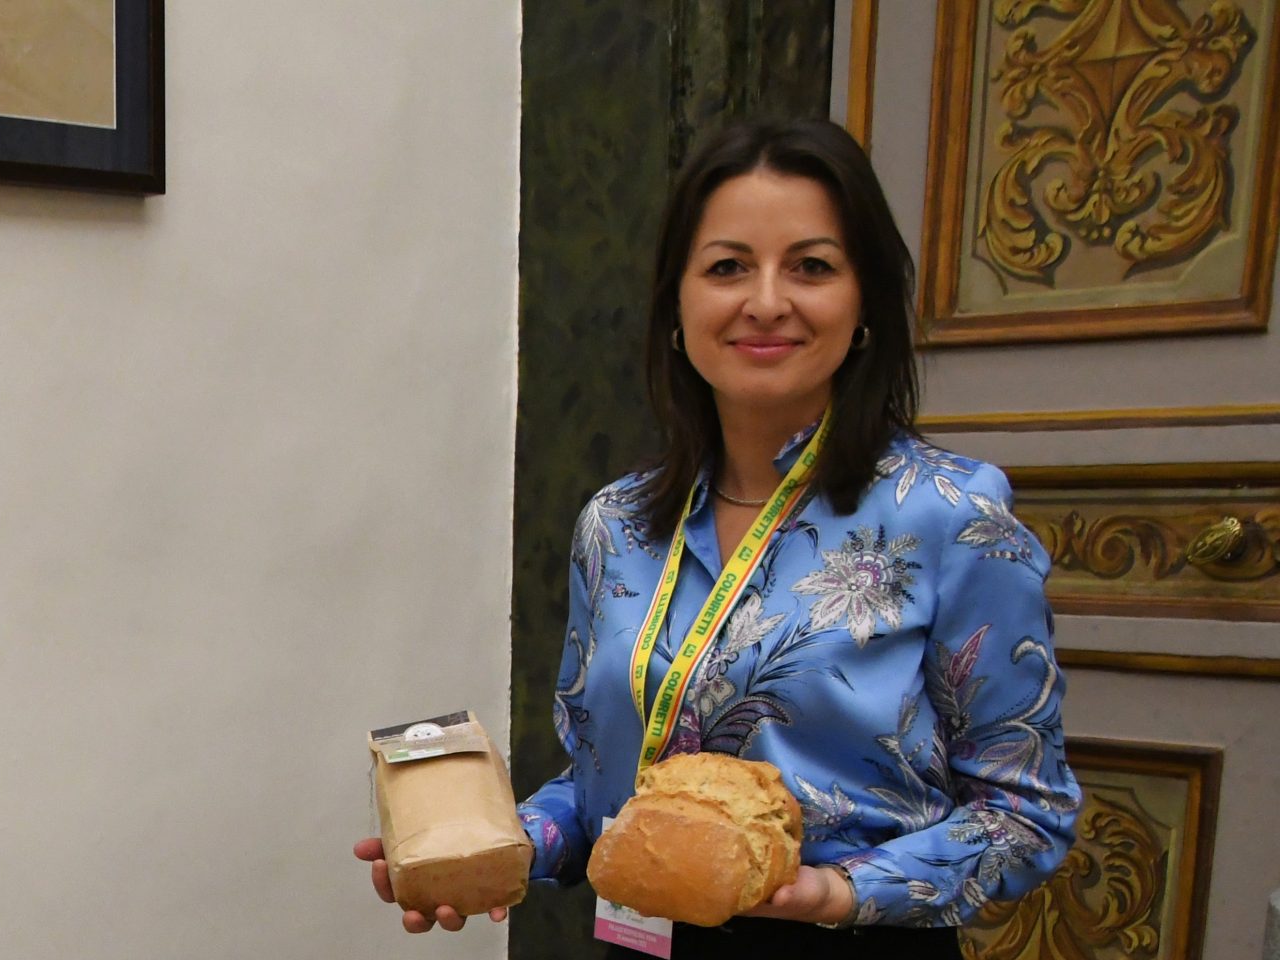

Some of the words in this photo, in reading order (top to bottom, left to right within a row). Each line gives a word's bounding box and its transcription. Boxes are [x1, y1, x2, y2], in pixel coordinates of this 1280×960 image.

[642, 592, 668, 650] COLDIRETTI
[696, 573, 737, 637] COLDIRETTI
[652, 671, 682, 737] COLDIRETTI
